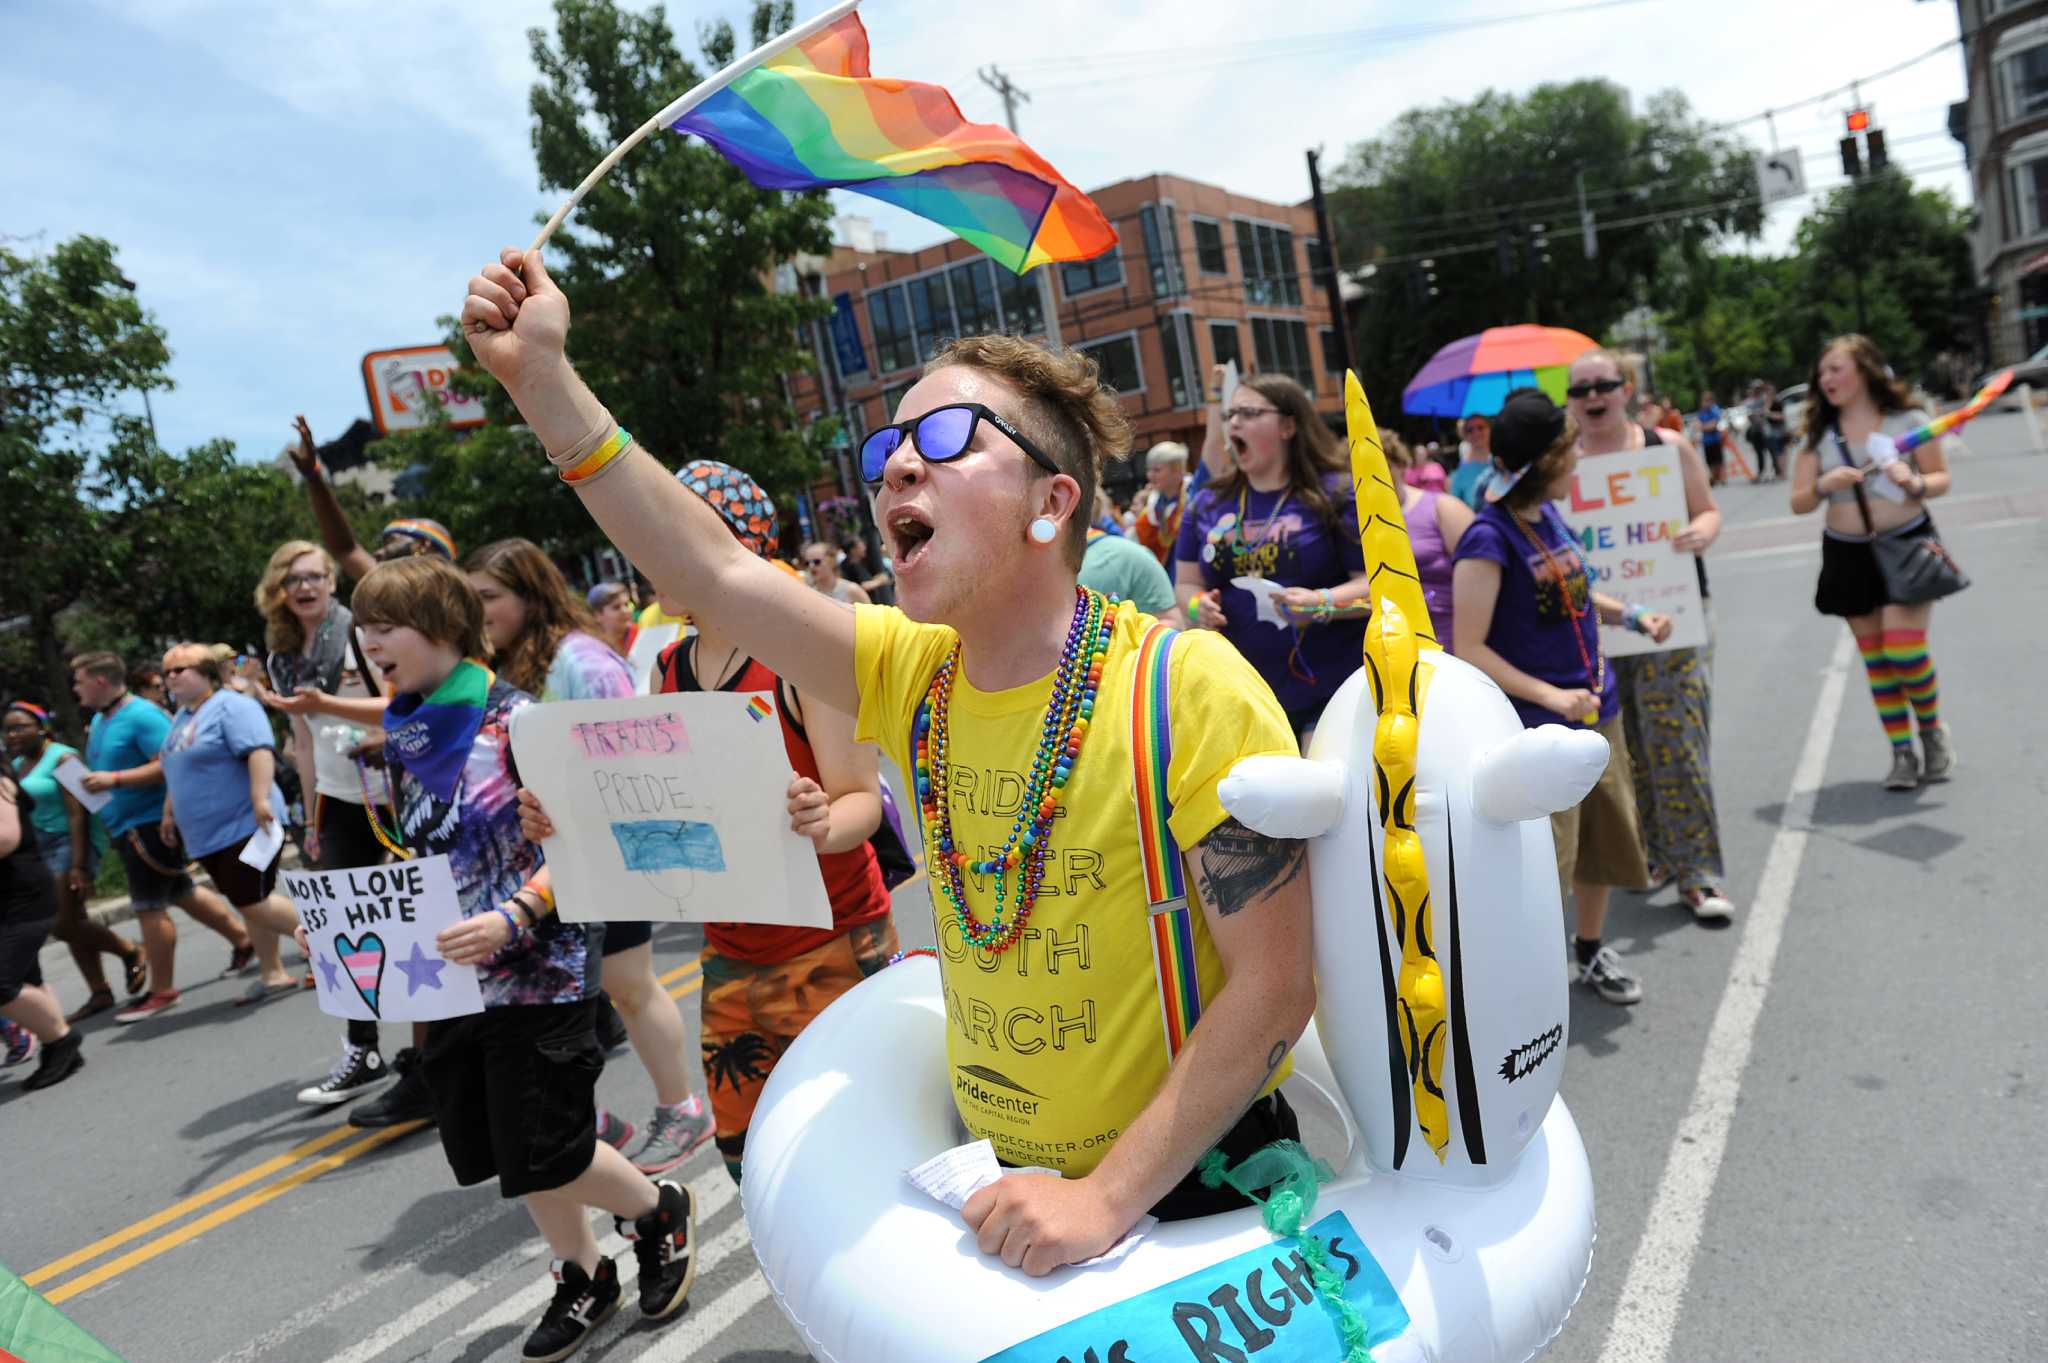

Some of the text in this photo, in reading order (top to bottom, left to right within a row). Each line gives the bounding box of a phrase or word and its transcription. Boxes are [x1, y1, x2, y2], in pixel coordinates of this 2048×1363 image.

[994, 415, 1017, 435] OAKLEY
[1570, 465, 1669, 513] LET
[593, 769, 694, 815] PRIDE
[285, 866, 424, 904] MORE LOVE
[303, 897, 416, 935] ESS HATE
[938, 914, 1091, 977] OUTH
[944, 981, 1097, 1055] ARCH
[956, 1074, 1039, 1116] pridecenter
[1172, 1236, 1360, 1363] RIGHS
